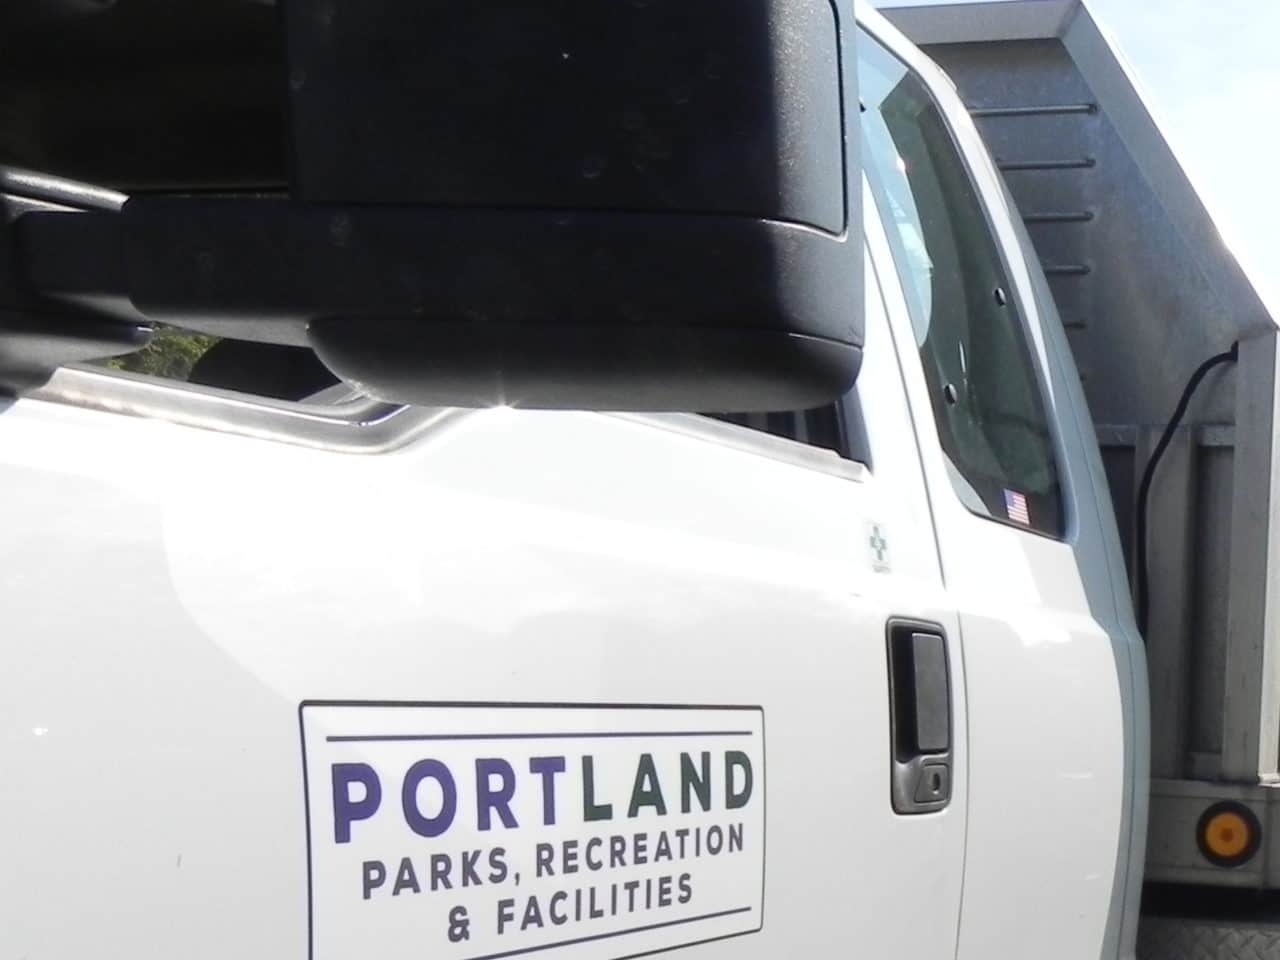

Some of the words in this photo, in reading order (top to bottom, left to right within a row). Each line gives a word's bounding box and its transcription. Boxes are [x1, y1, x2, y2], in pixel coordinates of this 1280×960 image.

[331, 750, 754, 844] PORTLAND
[362, 847, 521, 899] PARKS,
[535, 823, 744, 878] RECREATION
[447, 905, 470, 942] &
[497, 873, 693, 935] FACILITIES
